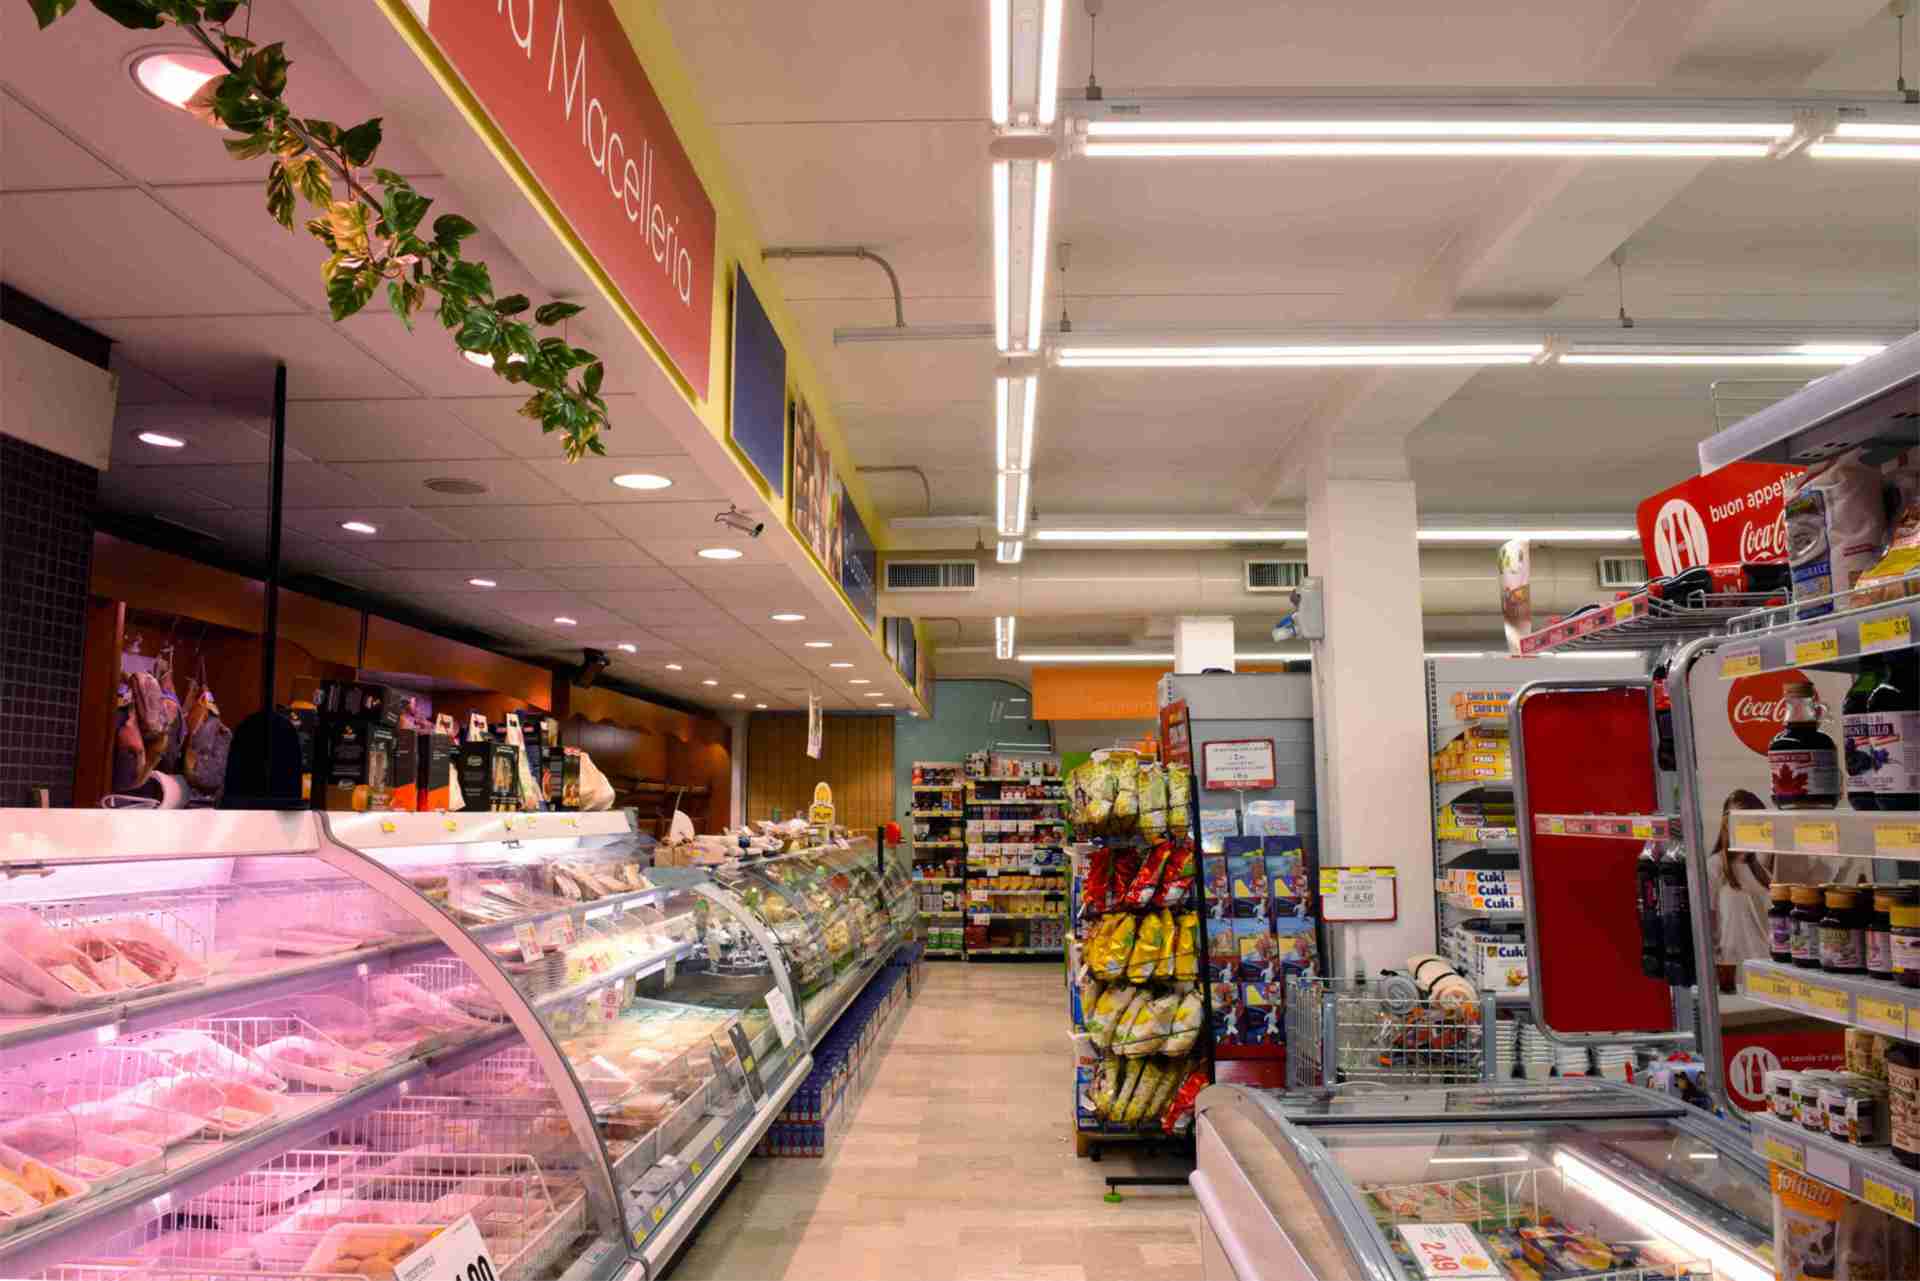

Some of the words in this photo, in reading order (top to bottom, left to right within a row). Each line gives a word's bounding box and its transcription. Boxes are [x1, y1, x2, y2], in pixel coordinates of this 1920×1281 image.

[548, 0, 691, 306] Macelleria
[1709, 498, 1745, 523] buon
[1477, 871, 1505, 882] Cuki
[1478, 883, 1508, 896] Cuki
[1485, 897, 1514, 909] Cuki
[1499, 945, 1528, 958] Cuki
